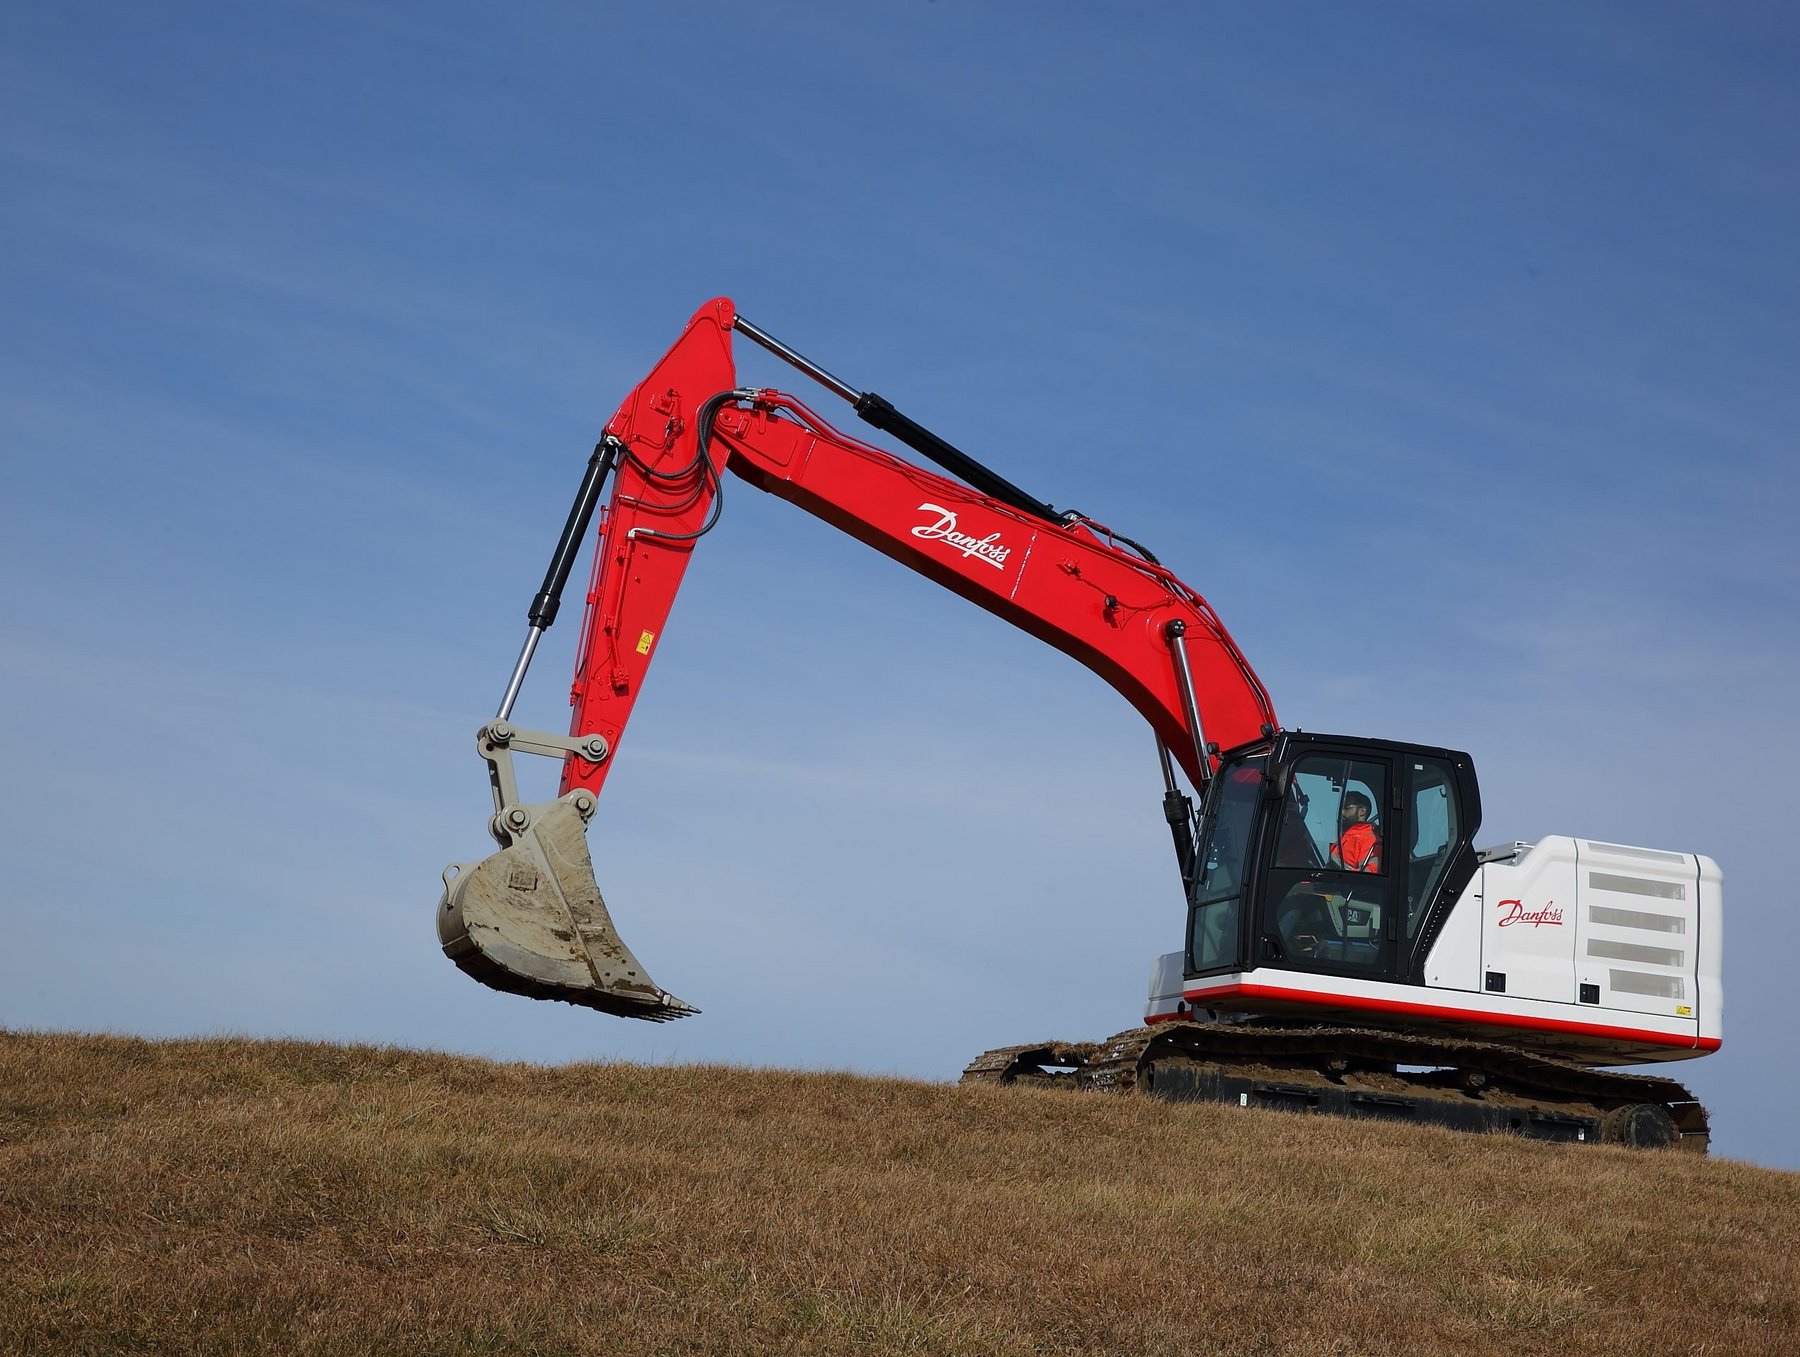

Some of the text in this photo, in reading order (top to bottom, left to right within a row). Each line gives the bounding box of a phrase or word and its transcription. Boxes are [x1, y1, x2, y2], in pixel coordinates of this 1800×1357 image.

[911, 502, 1011, 571] Danfoss
[1347, 909, 1360, 923] CA
[1497, 899, 1563, 928] Danfoss
